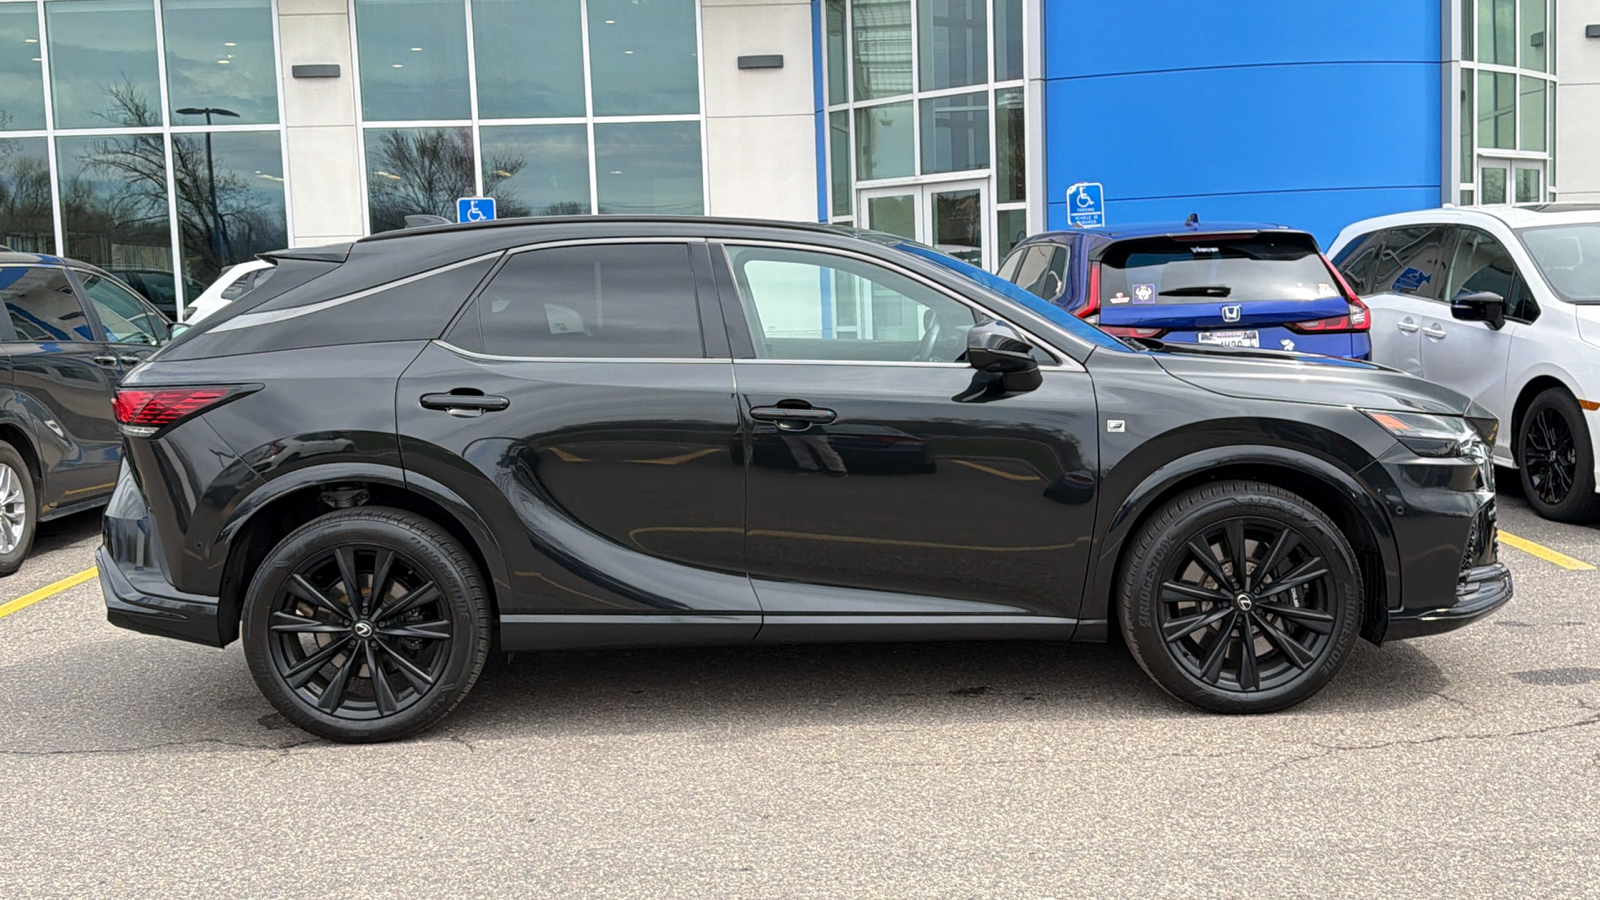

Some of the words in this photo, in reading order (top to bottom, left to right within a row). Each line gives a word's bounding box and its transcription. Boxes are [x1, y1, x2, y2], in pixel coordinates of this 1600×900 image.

[409, 536, 471, 620] BRIDGESTONE
[1139, 533, 1177, 628] BRIDGESTONE
[1320, 582, 1357, 676] BRIDGESTONE
